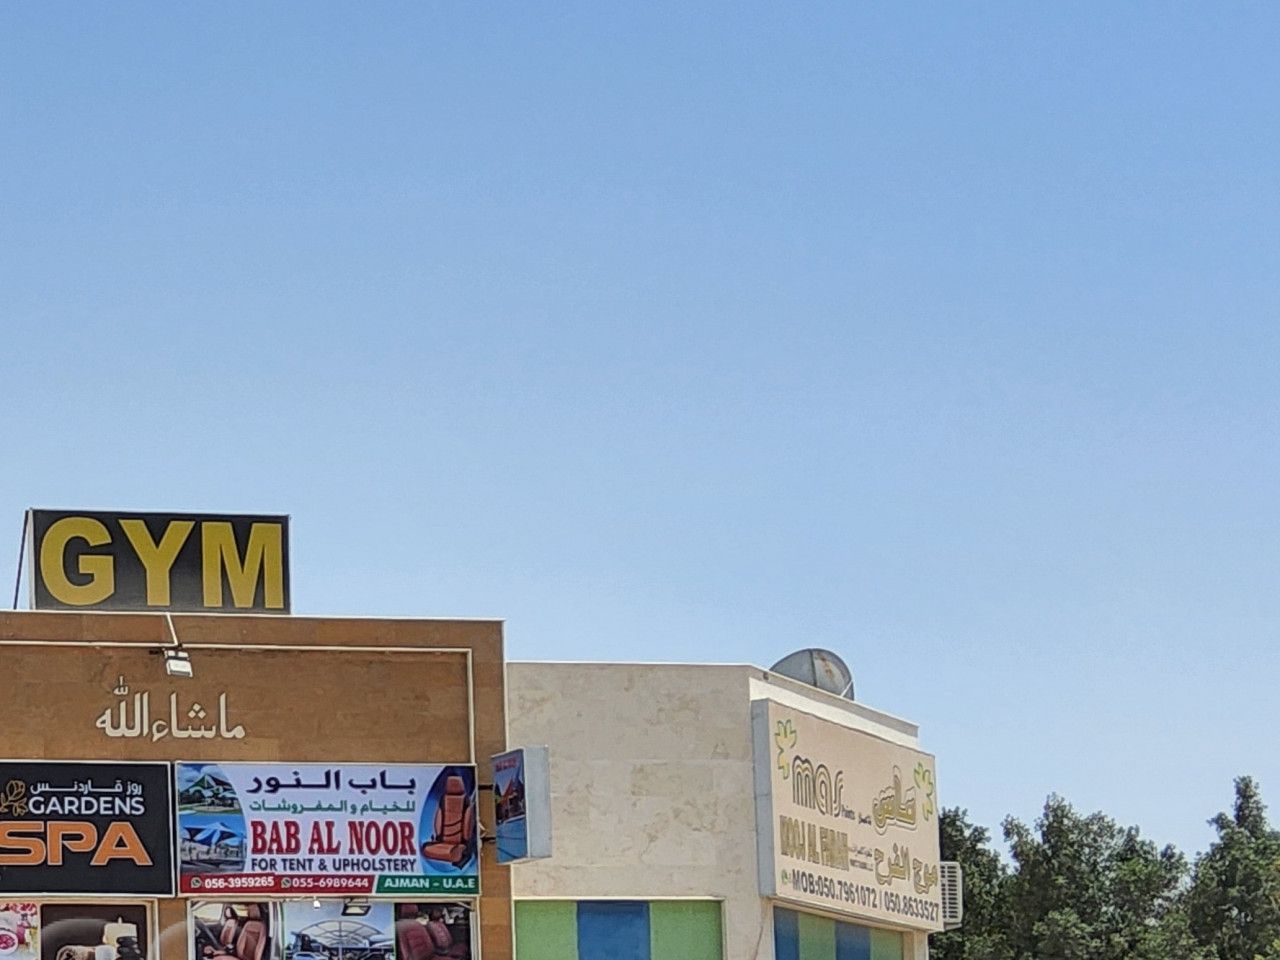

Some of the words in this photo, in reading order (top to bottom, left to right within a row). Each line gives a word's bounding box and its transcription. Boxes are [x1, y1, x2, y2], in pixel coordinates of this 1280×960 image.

[40, 517, 284, 608] GYM
[126, 782, 142, 796] روز
[246, 769, 341, 794] النور
[349, 770, 417, 795] باب
[28, 796, 145, 816] GARDENS
[249, 798, 348, 814] المفروشات
[361, 800, 416, 815] للخيام
[250, 820, 300, 855] BAB
[308, 820, 342, 856] AL
[348, 821, 417, 856] NOOR
[251, 858, 277, 872] FOR
[281, 859, 316, 872] TENT
[318, 860, 328, 872] &
[332, 859, 417, 873] UPHOLSTERY
[205, 876, 275, 889] 056-3959265
[292, 878, 369, 889] 055-6989644
[384, 878, 430, 889] AJMAN
[442, 877, 475, 889] U.A.E
